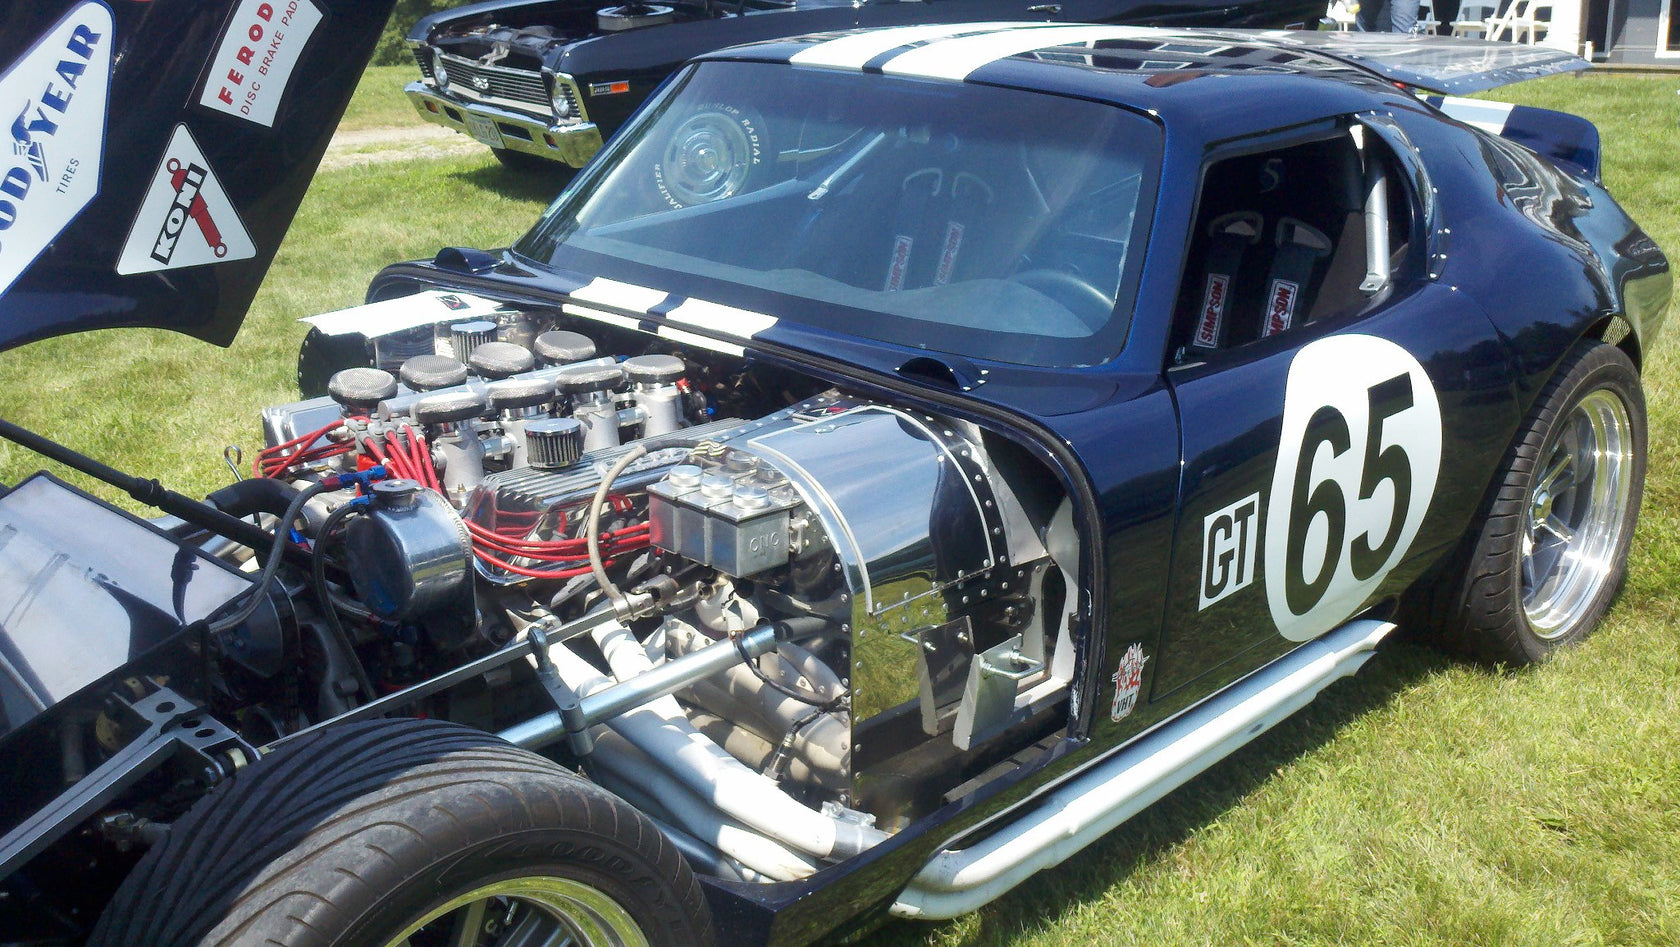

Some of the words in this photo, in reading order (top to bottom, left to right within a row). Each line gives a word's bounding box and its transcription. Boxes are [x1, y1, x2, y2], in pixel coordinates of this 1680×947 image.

[218, 2, 274, 105] FEROD
[240, 81, 261, 115] DISC
[258, 30, 285, 76] BRAKE
[281, 0, 300, 26] PAD
[0, 24, 102, 231] ODYEAR
[741, 118, 761, 165] RADIAL
[56, 157, 80, 195] TIRES
[151, 163, 208, 265] KONI
[654, 163, 683, 210] UALIFIER
[1200, 280, 1224, 343] SIMPSON
[1270, 286, 1292, 337] MPSON
[1285, 372, 1414, 616] 65
[750, 531, 780, 552] CNC
[1204, 500, 1256, 600] GT
